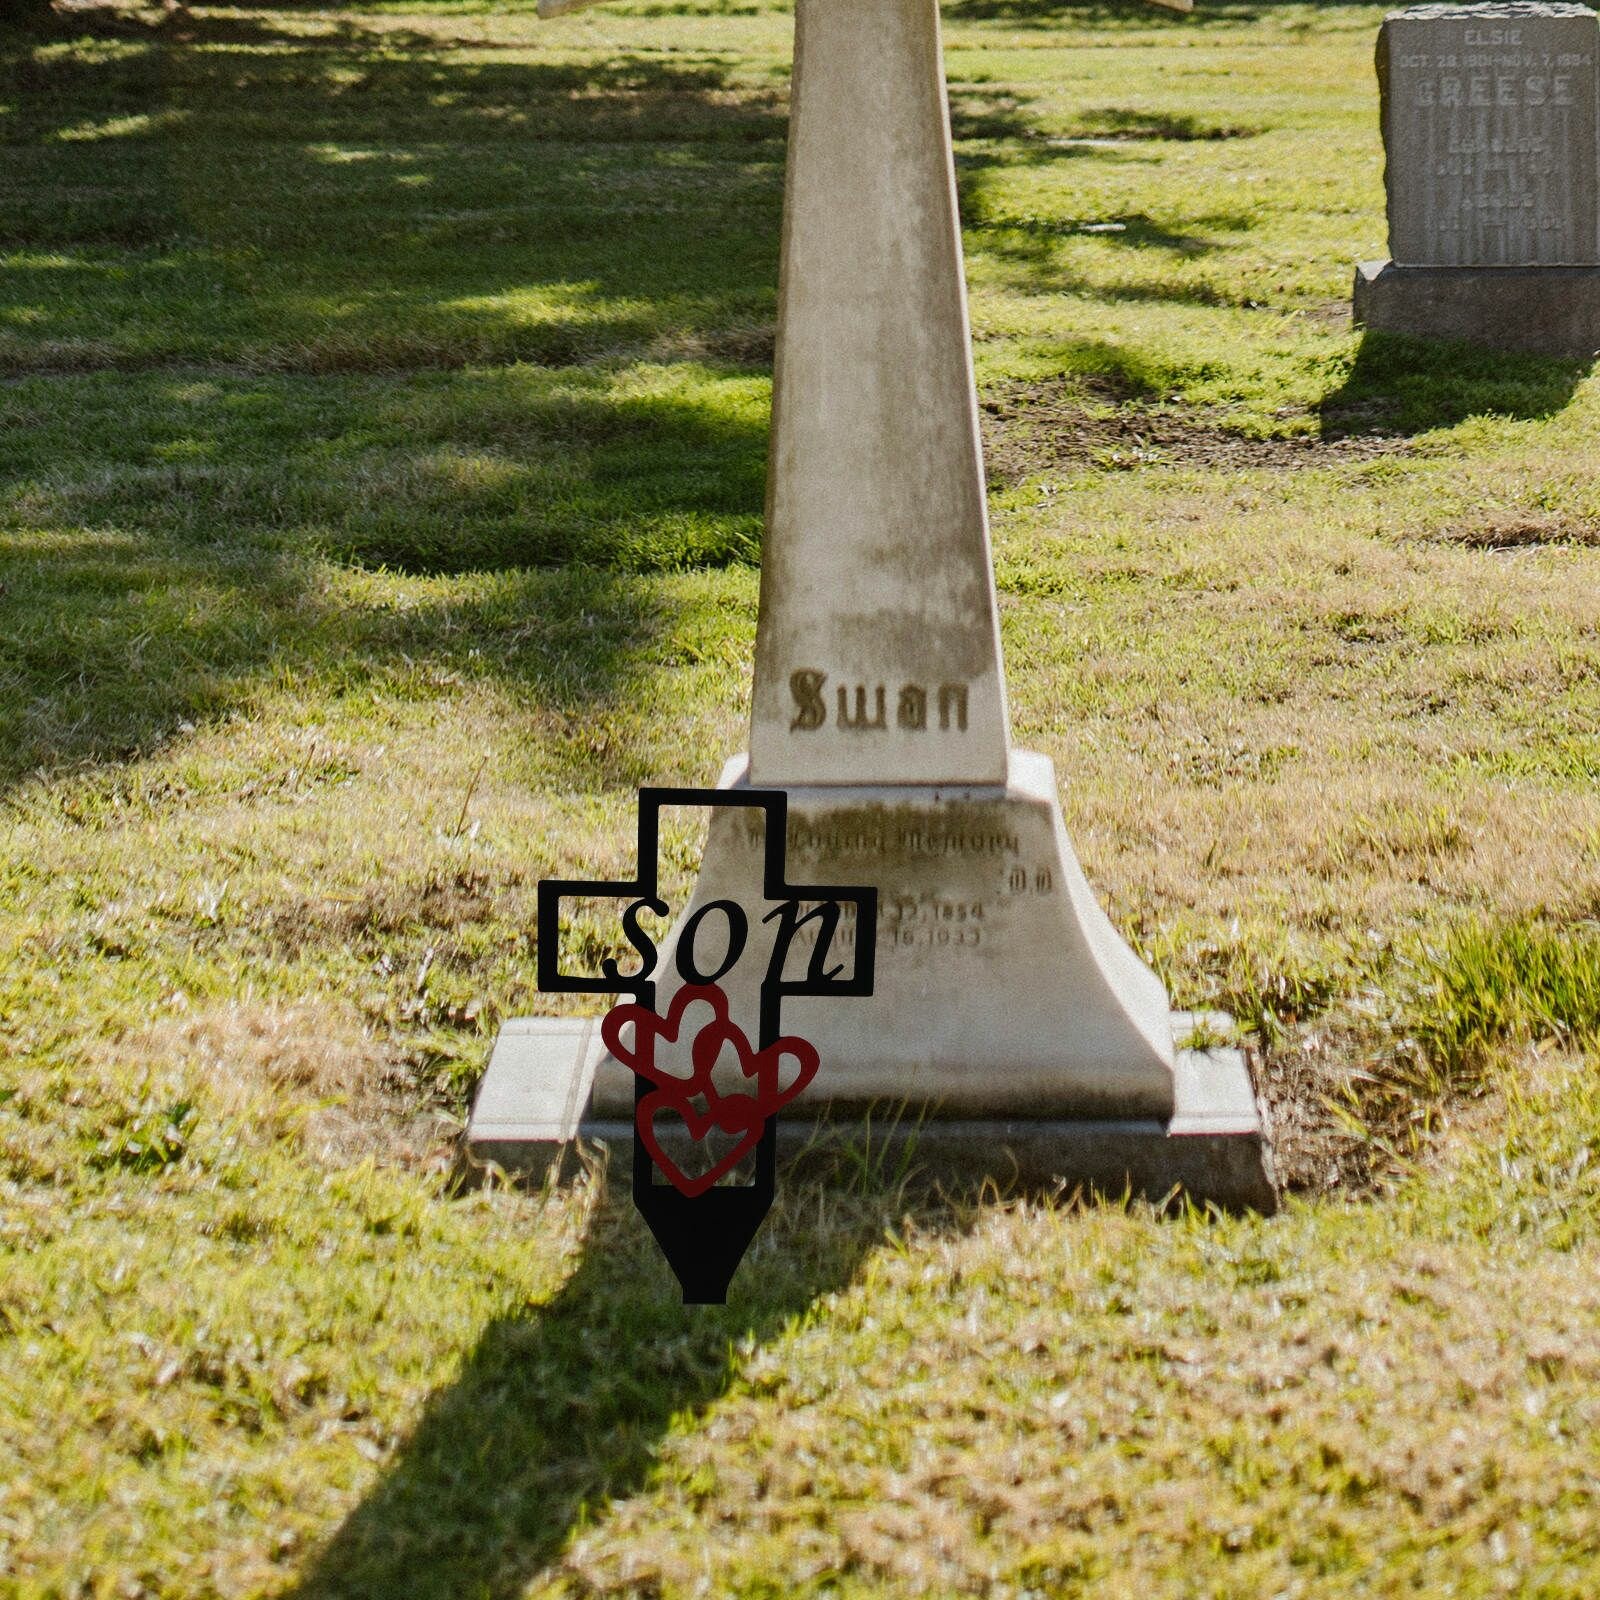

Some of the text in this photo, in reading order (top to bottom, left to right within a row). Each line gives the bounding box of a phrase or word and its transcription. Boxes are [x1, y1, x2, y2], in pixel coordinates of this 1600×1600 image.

[1464, 29, 1523, 46] ELSIE
[1414, 75, 1575, 106] GREESE
[789, 667, 969, 733] Swan
[602, 898, 845, 986] son
